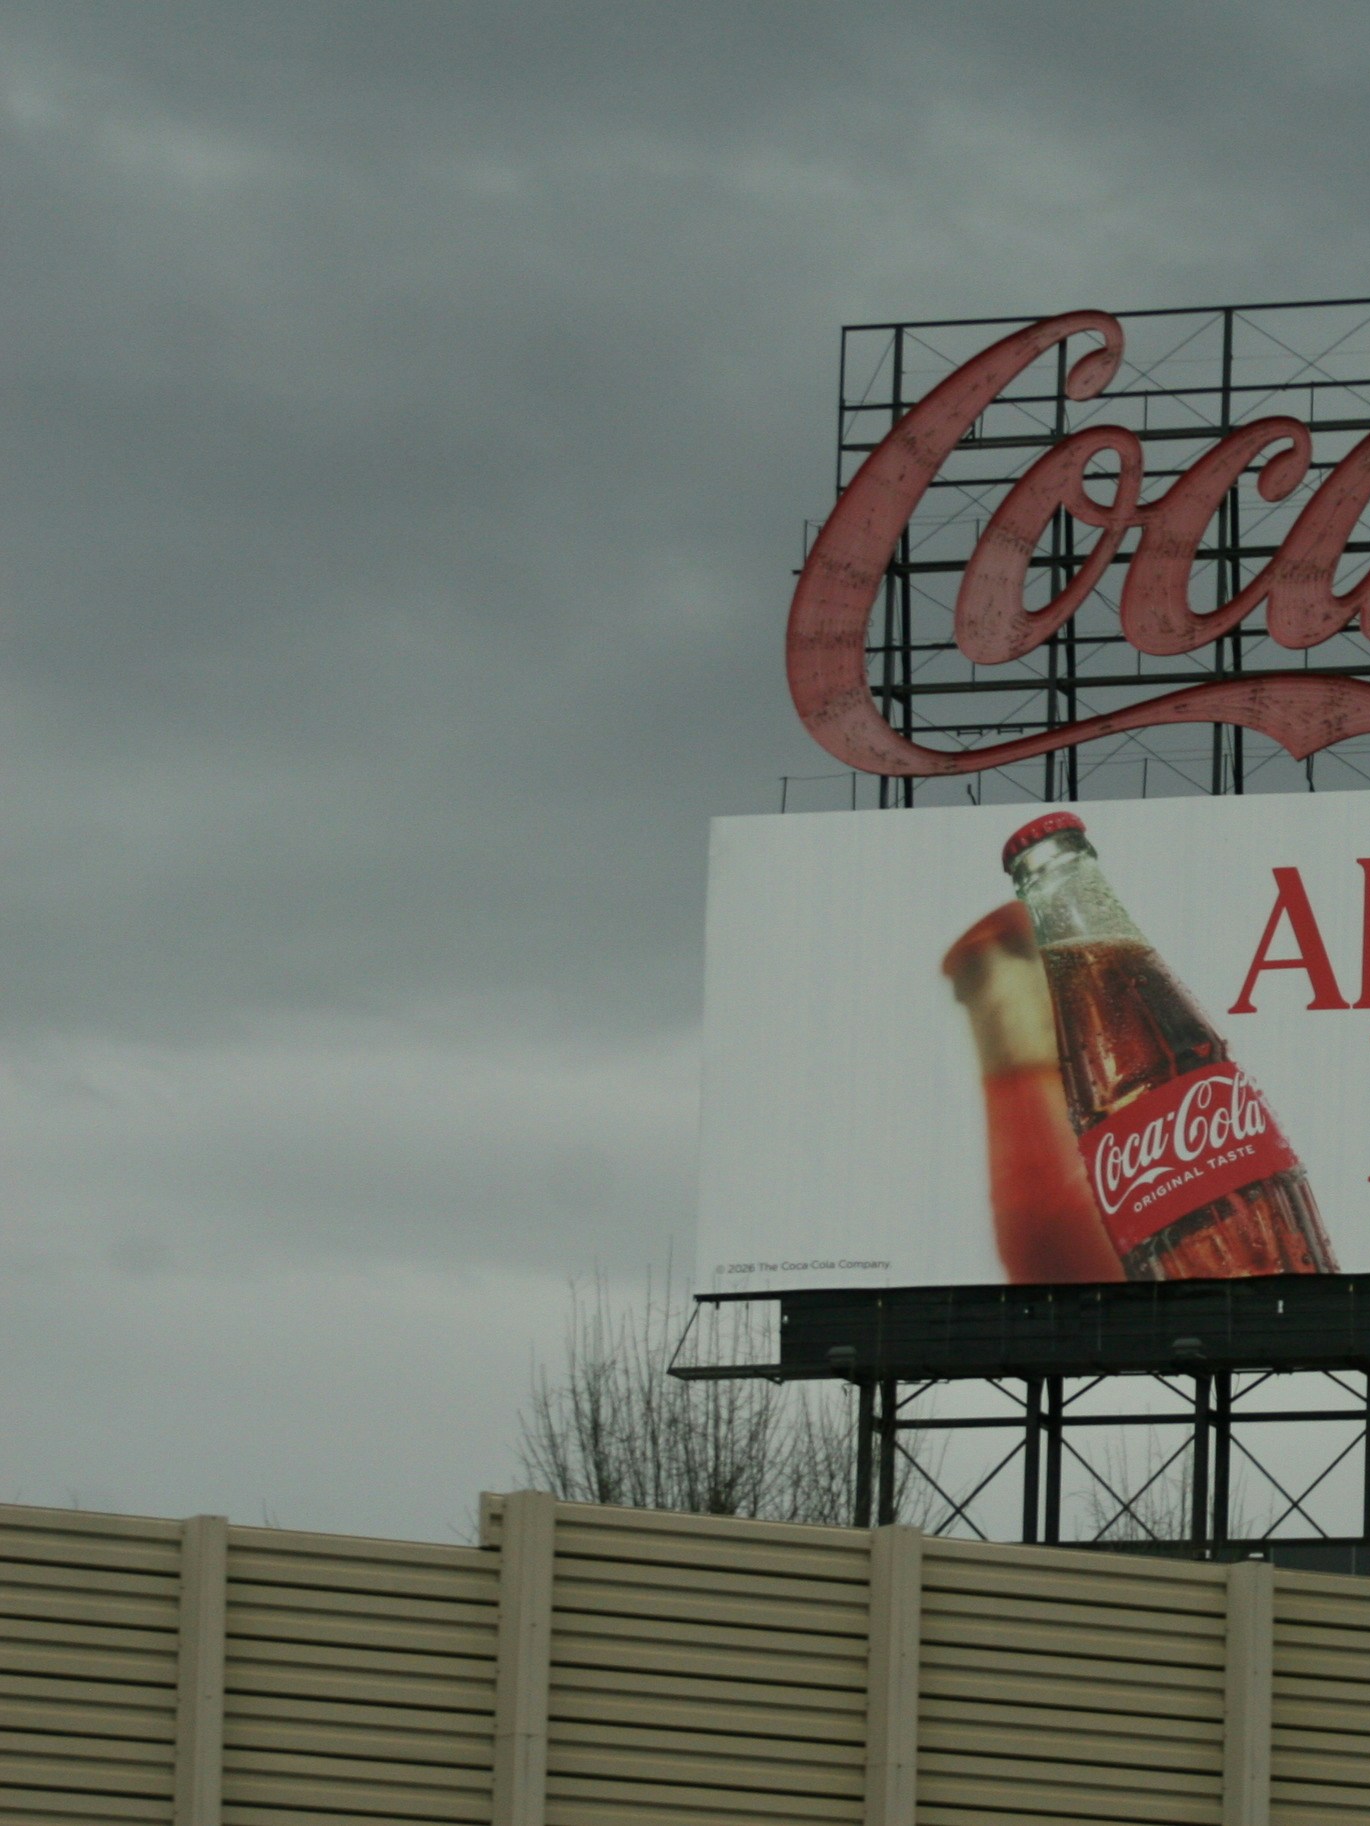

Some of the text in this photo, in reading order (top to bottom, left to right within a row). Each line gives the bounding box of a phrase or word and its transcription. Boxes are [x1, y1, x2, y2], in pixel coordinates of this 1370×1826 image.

[1094, 1072, 1267, 1215] Coca-Cola
[1133, 1144, 1256, 1213] ORIGINAL TASTE
[727, 1263, 756, 1274] 2026
[759, 1261, 779, 1273] The
